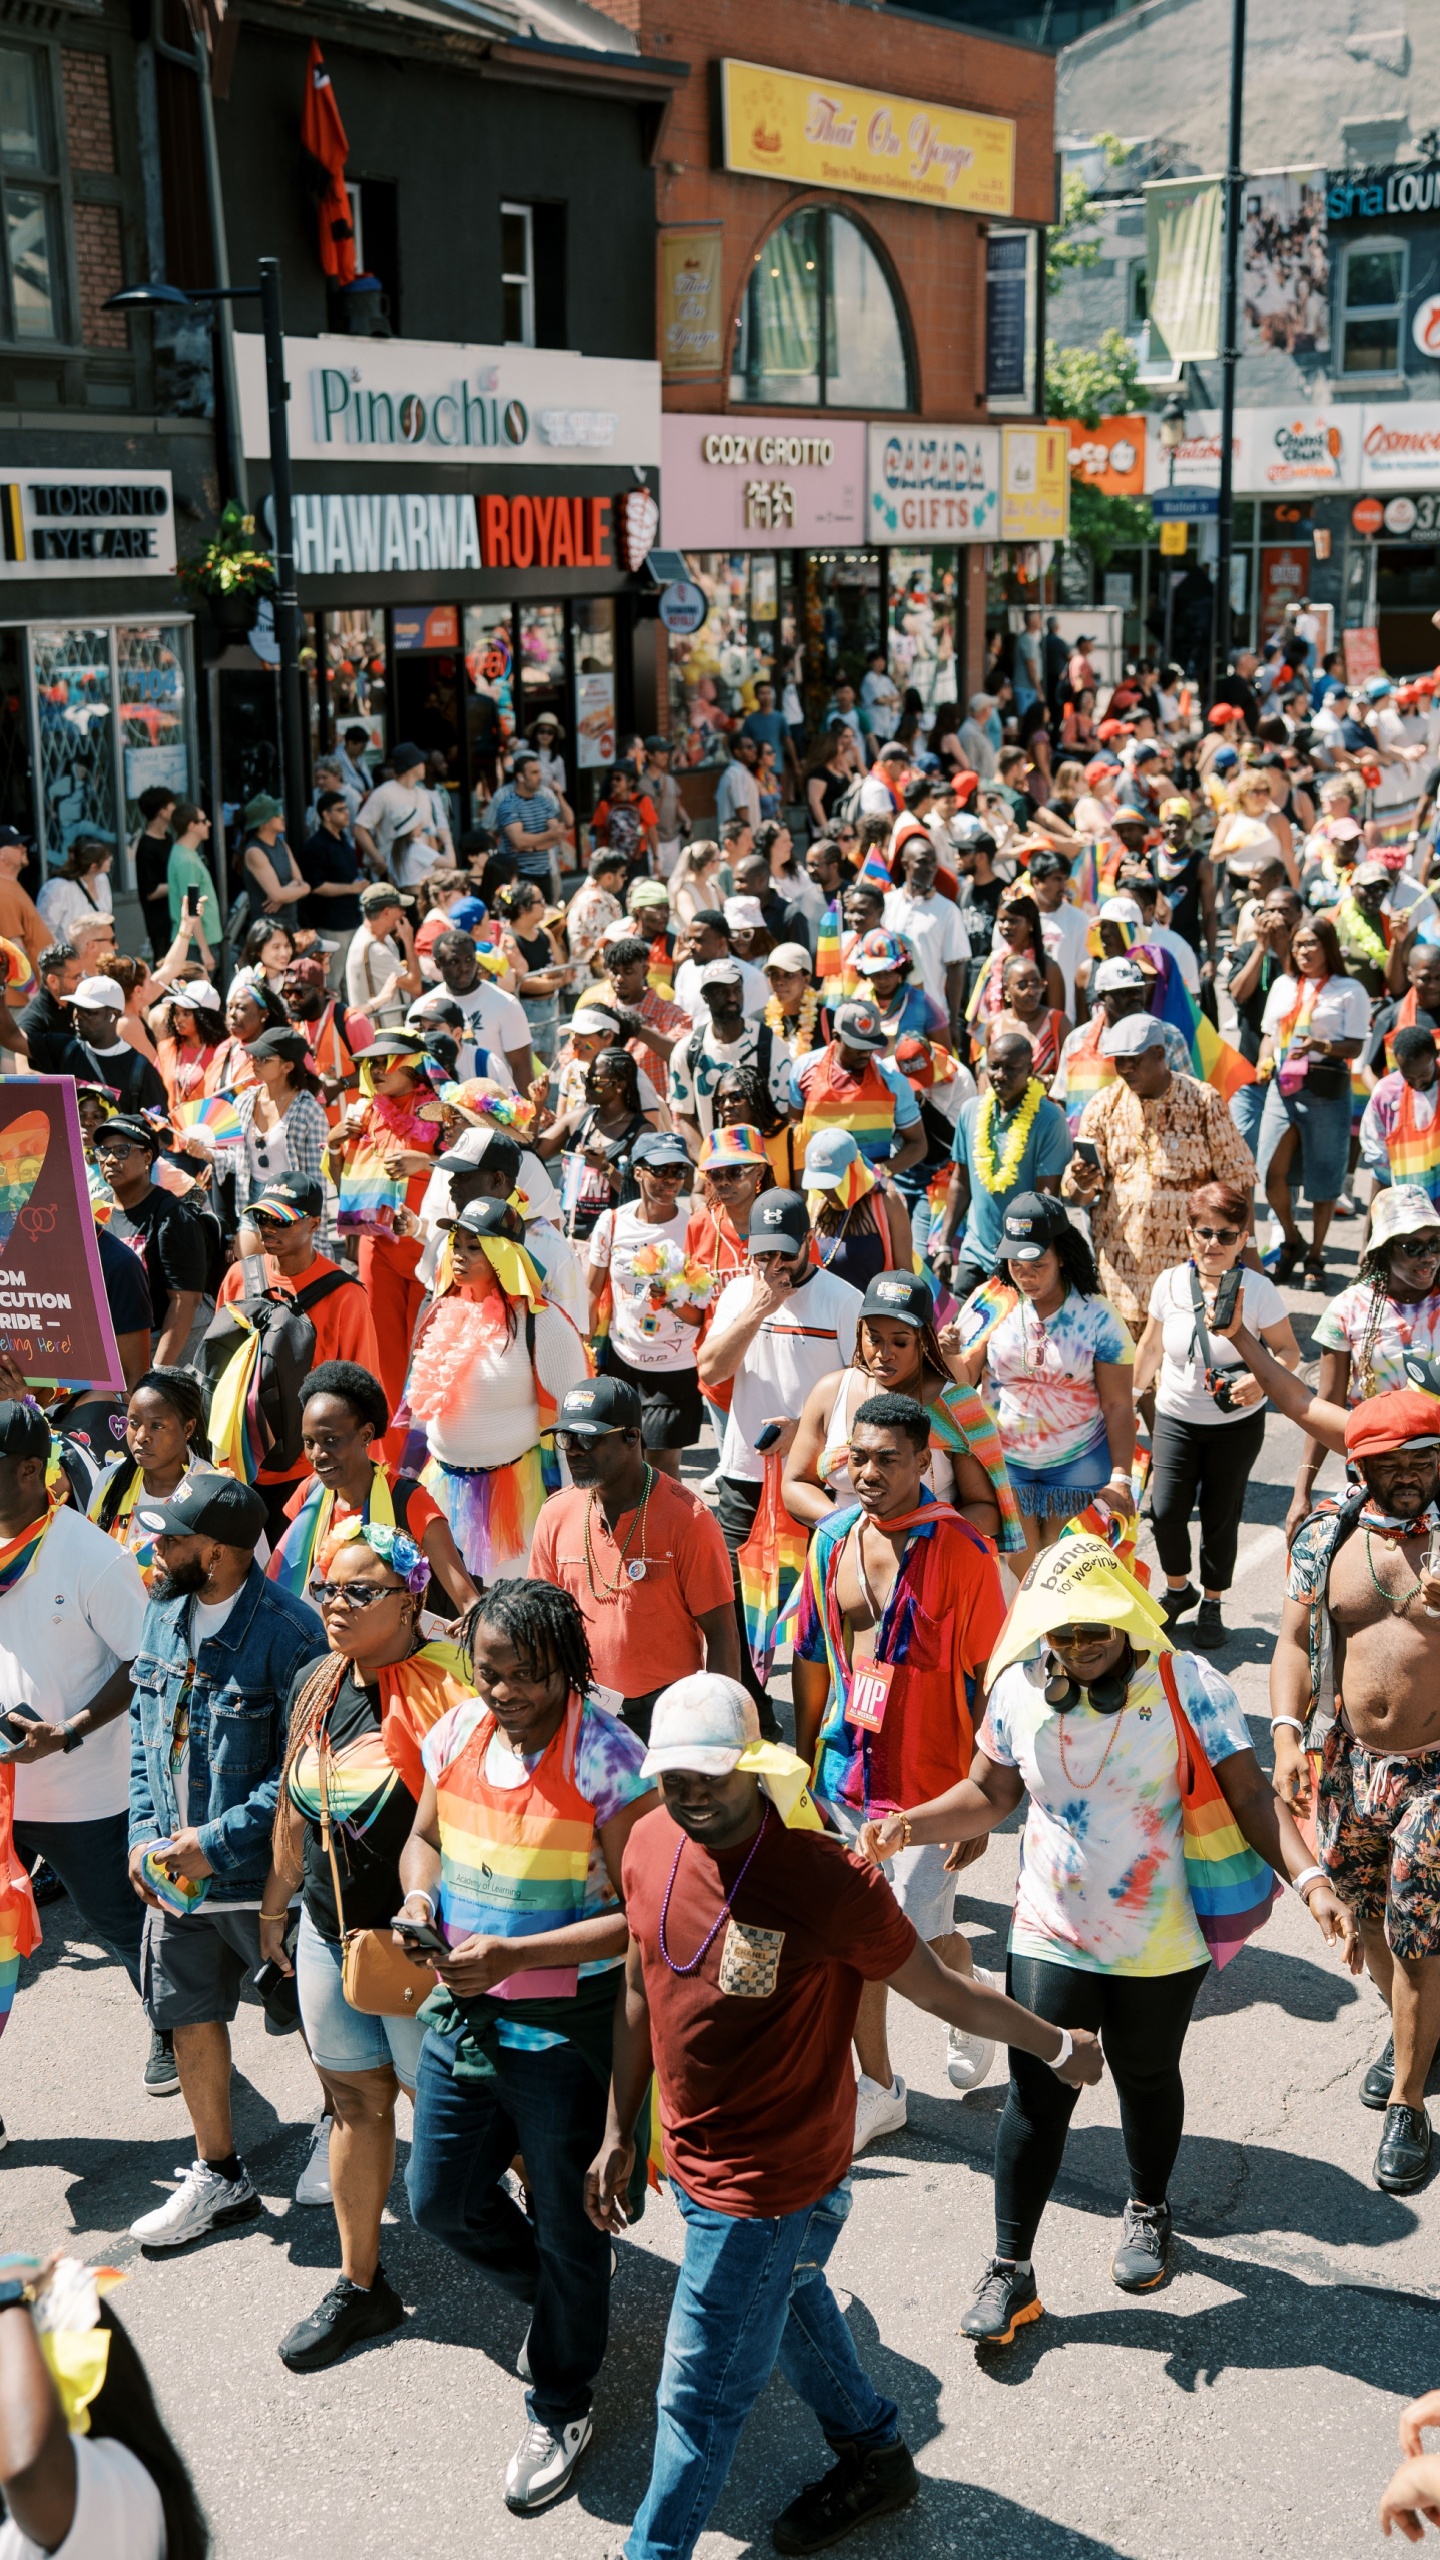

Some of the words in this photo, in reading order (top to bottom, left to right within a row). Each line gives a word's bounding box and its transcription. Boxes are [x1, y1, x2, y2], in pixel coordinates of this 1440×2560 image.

[804, 92, 857, 149] Thai
[868, 107, 901, 156] On
[908, 113, 974, 188] Yonge
[312, 368, 530, 446] Pinochio
[704, 434, 759, 464] COZY
[760, 436, 835, 467] GROTTO
[884, 437, 985, 491] CANADA
[30, 485, 168, 516] TORONTO
[901, 499, 969, 529] GIFTS
[35, 528, 159, 560] EYECARE
[483, 495, 612, 568] ROYALE
[0, 1292, 72, 1309] CUTION
[0, 1313, 43, 1330] RIDE
[37, 1334, 74, 1354] Here!
[1057, 1579, 1075, 1595] for
[852, 1673, 887, 1715] VIP
[849, 1707, 857, 1715] ALL
[857, 1710, 878, 1722] WEEKEND
[456, 1874, 481, 1890] Academy
[482, 1881, 491, 1890] of
[491, 1884, 522, 1898] Learning
[734, 1947, 768, 1960] CHANEL
